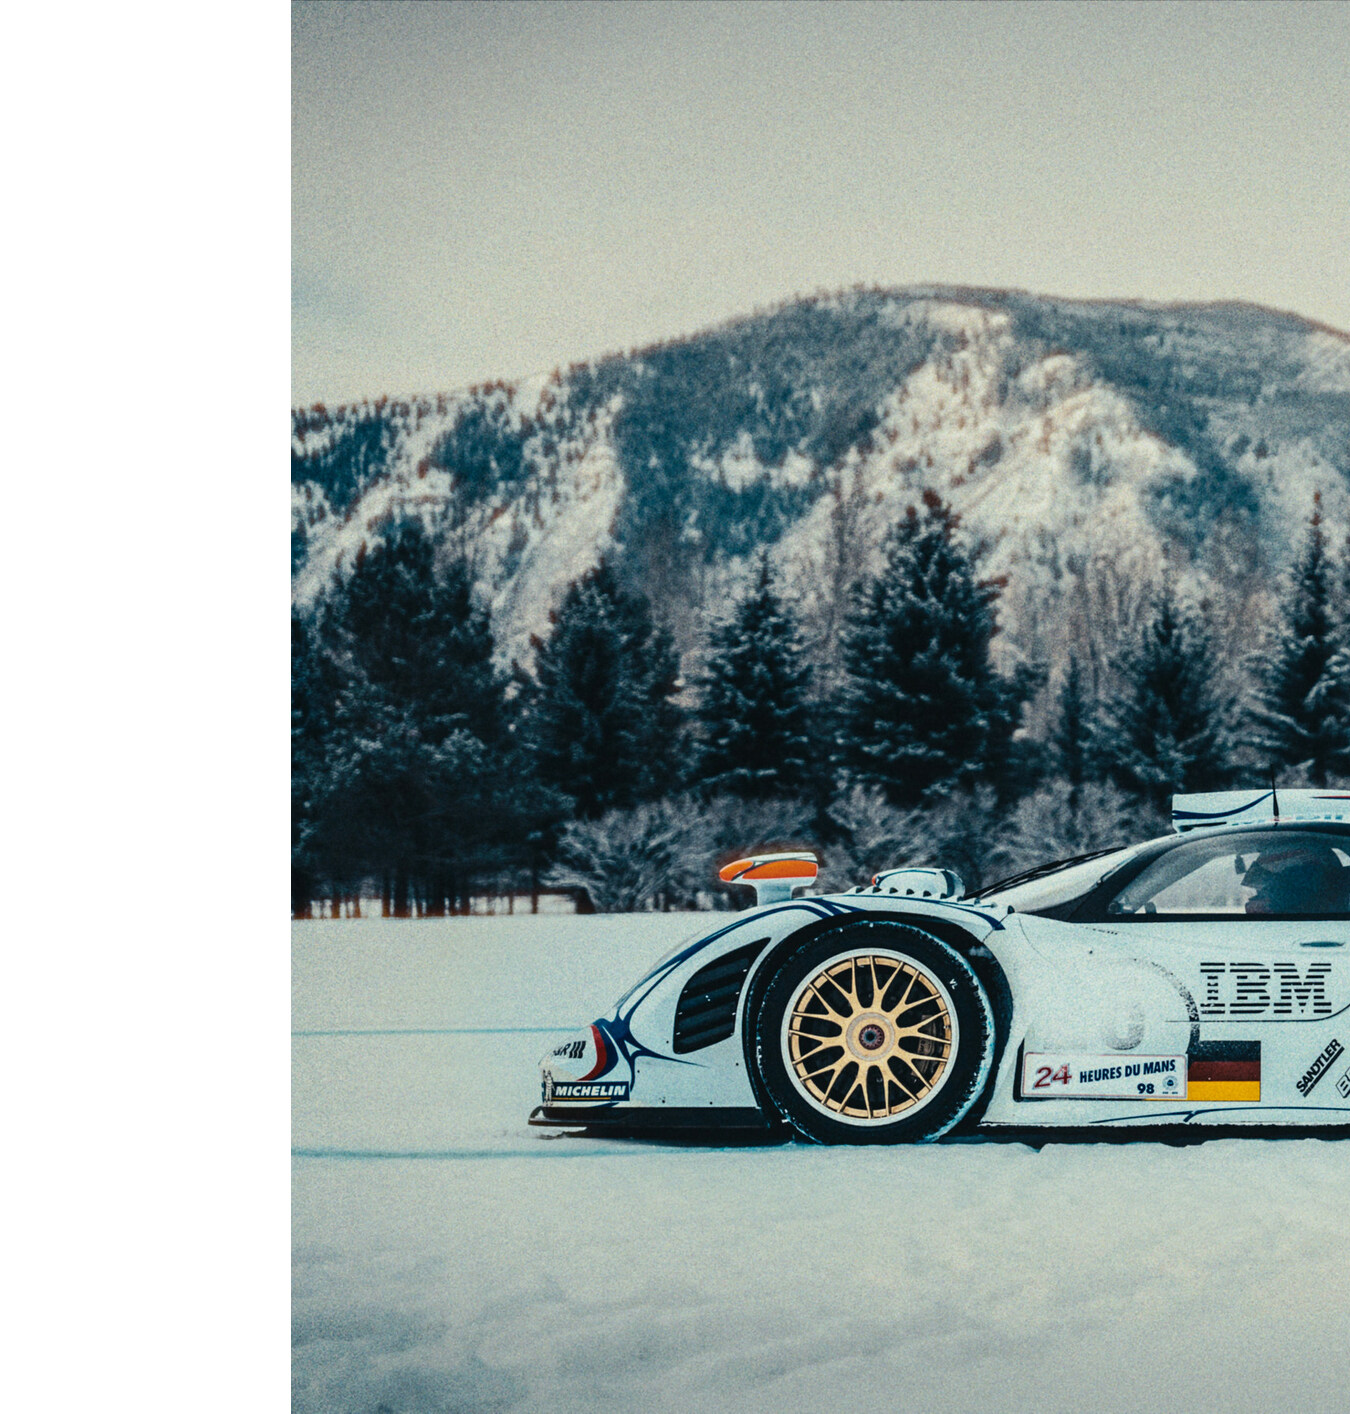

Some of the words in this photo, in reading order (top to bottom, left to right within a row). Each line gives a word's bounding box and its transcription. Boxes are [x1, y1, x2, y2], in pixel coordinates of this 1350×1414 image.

[1200, 962, 1332, 1014] IBM
[1033, 1063, 1072, 1090] 24
[1080, 1066, 1122, 1083] HEURES
[1125, 1063, 1141, 1077] DU
[1143, 1059, 1176, 1075] MANS
[1296, 1038, 1341, 1093] SANDTLER
[555, 1085, 627, 1096] MICHELIN
[1137, 1083, 1155, 1094] 98
